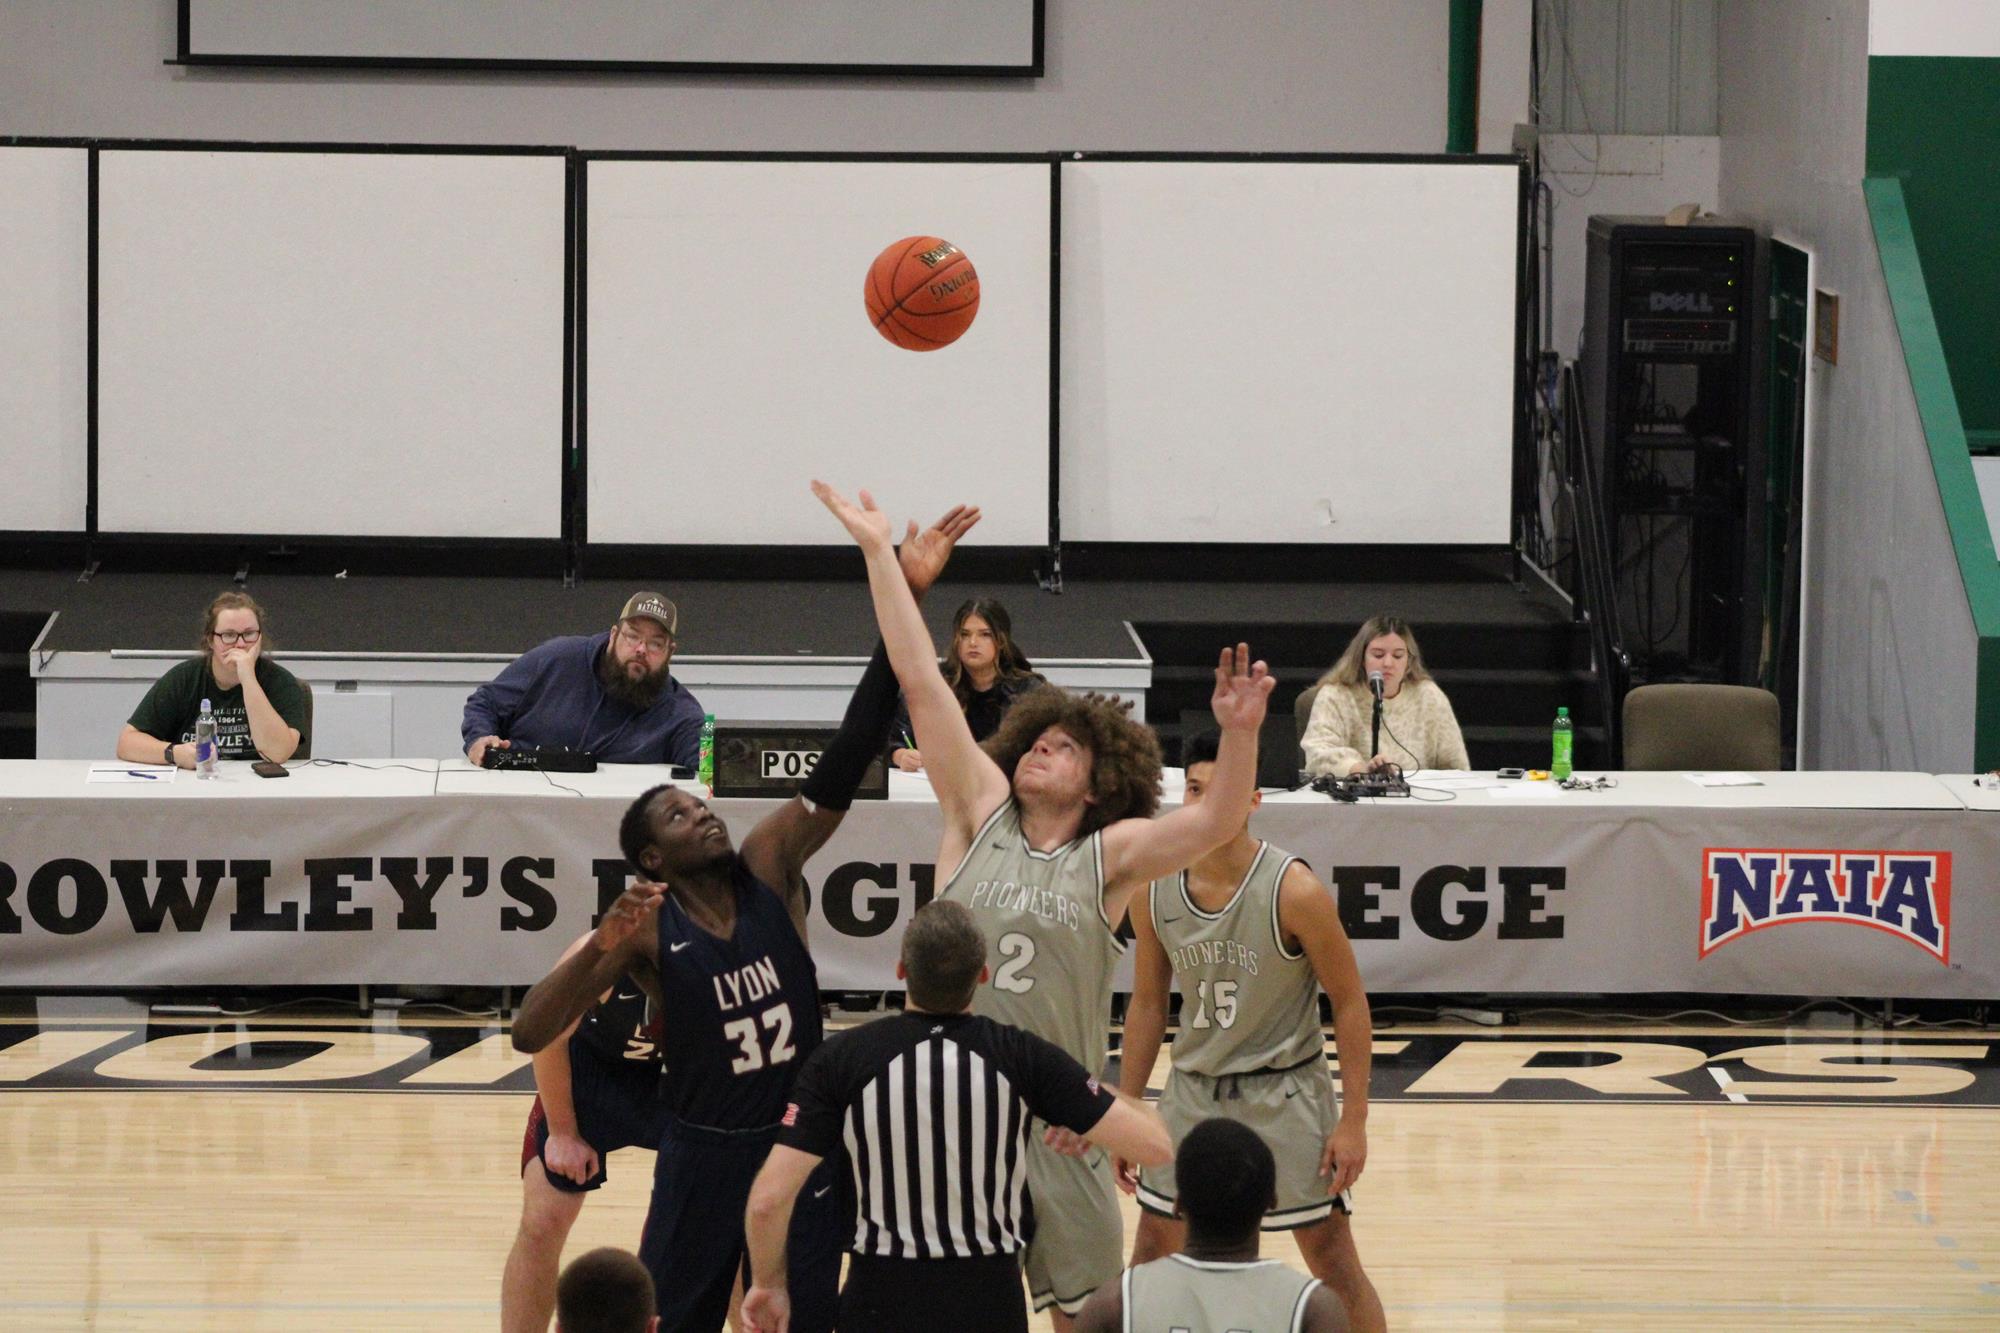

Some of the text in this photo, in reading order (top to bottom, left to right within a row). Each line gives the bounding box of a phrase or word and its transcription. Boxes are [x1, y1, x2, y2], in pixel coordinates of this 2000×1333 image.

[1650, 292, 1713, 313] DELL
[637, 602, 668, 619] NATIONAL
[763, 752, 818, 777] POS
[969, 880, 1080, 932] PIONEERS
[1703, 851, 1946, 959] NAIA
[993, 931, 1036, 994] 2
[1171, 939, 1258, 976] PIONEERS
[712, 955, 781, 1012] LYON
[1191, 979, 1238, 1029] 15
[723, 1002, 796, 1075] 32
